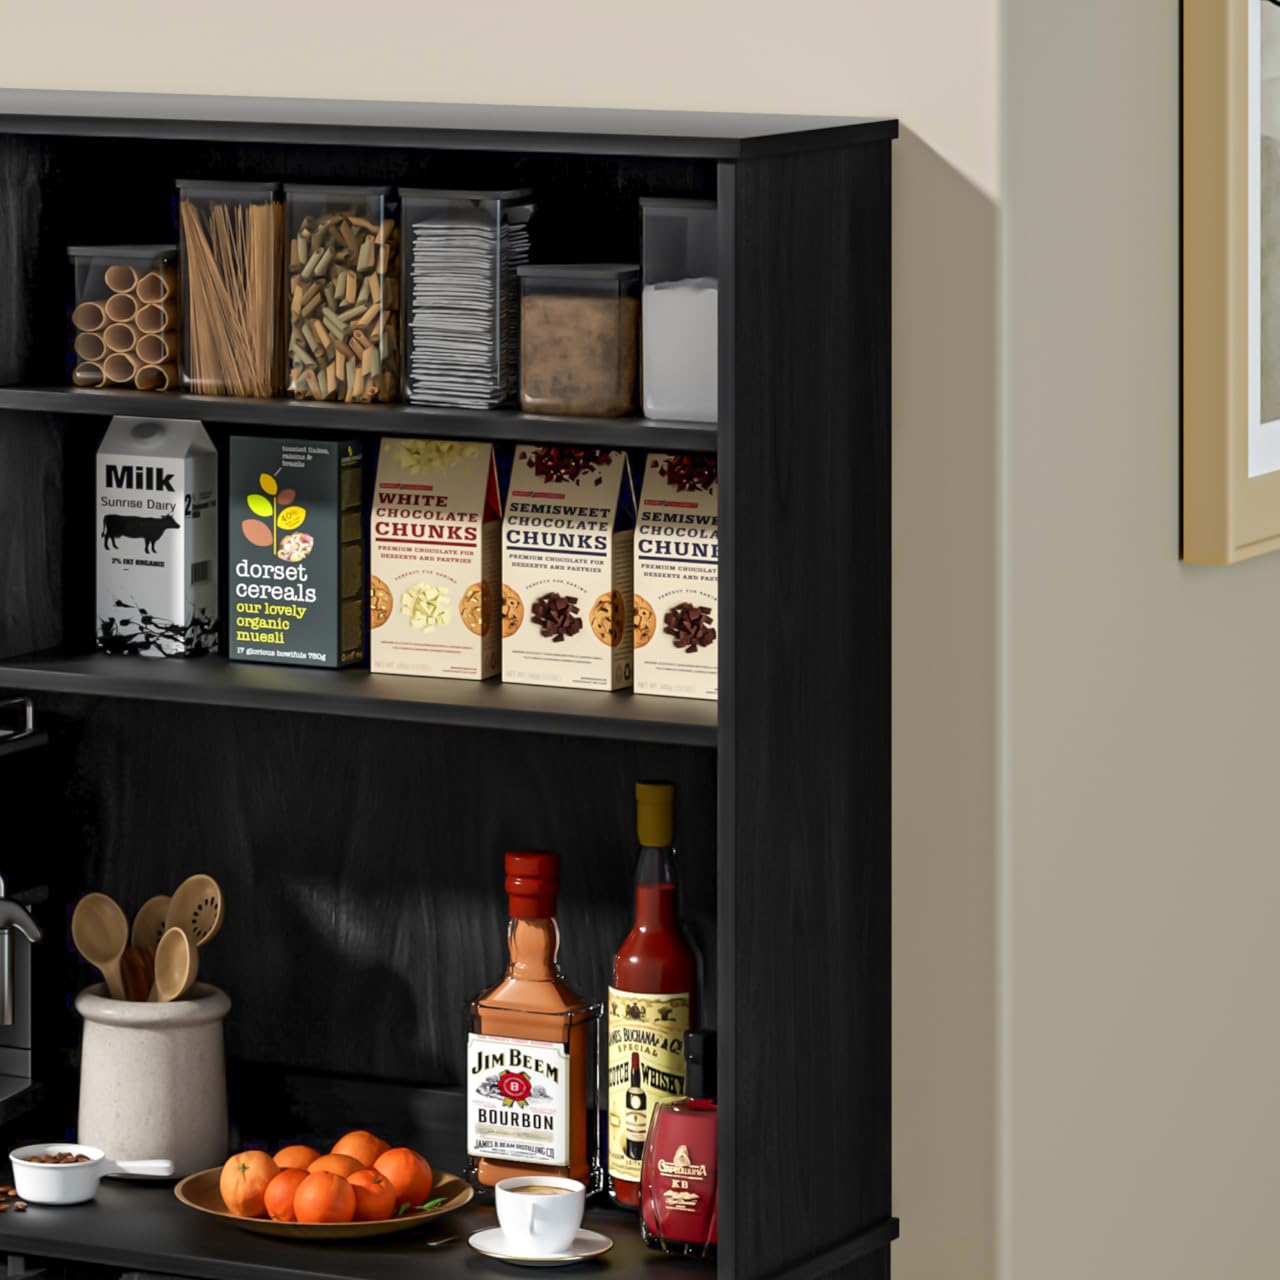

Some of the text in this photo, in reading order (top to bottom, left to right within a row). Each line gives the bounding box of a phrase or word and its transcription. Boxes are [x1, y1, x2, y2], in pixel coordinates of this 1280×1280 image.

[106, 464, 175, 492] Milk
[101, 496, 143, 508] Sunrise
[147, 498, 177, 512] Dairy
[378, 493, 448, 507] WHITE
[376, 508, 479, 523] CHOCOLATE
[510, 502, 611, 518] SEMISWEET
[507, 516, 608, 531] CHOCOLATE
[642, 512, 719, 525] SEMISWE
[376, 522, 477, 541] CHUNKS
[640, 525, 718, 539] CHOCOLA
[506, 530, 607, 550] CHUNKS
[236, 559, 308, 581] dorset
[236, 583, 317, 602] cereals
[236, 602, 307, 619] our lovely
[236, 617, 290, 630] organic
[236, 631, 284, 644] muesli
[618, 1044, 658, 1057] SPECIAL
[472, 1048, 558, 1084] JIM BEEM
[641, 1062, 685, 1095] WHISKY
[478, 1108, 554, 1131] BOURBON
